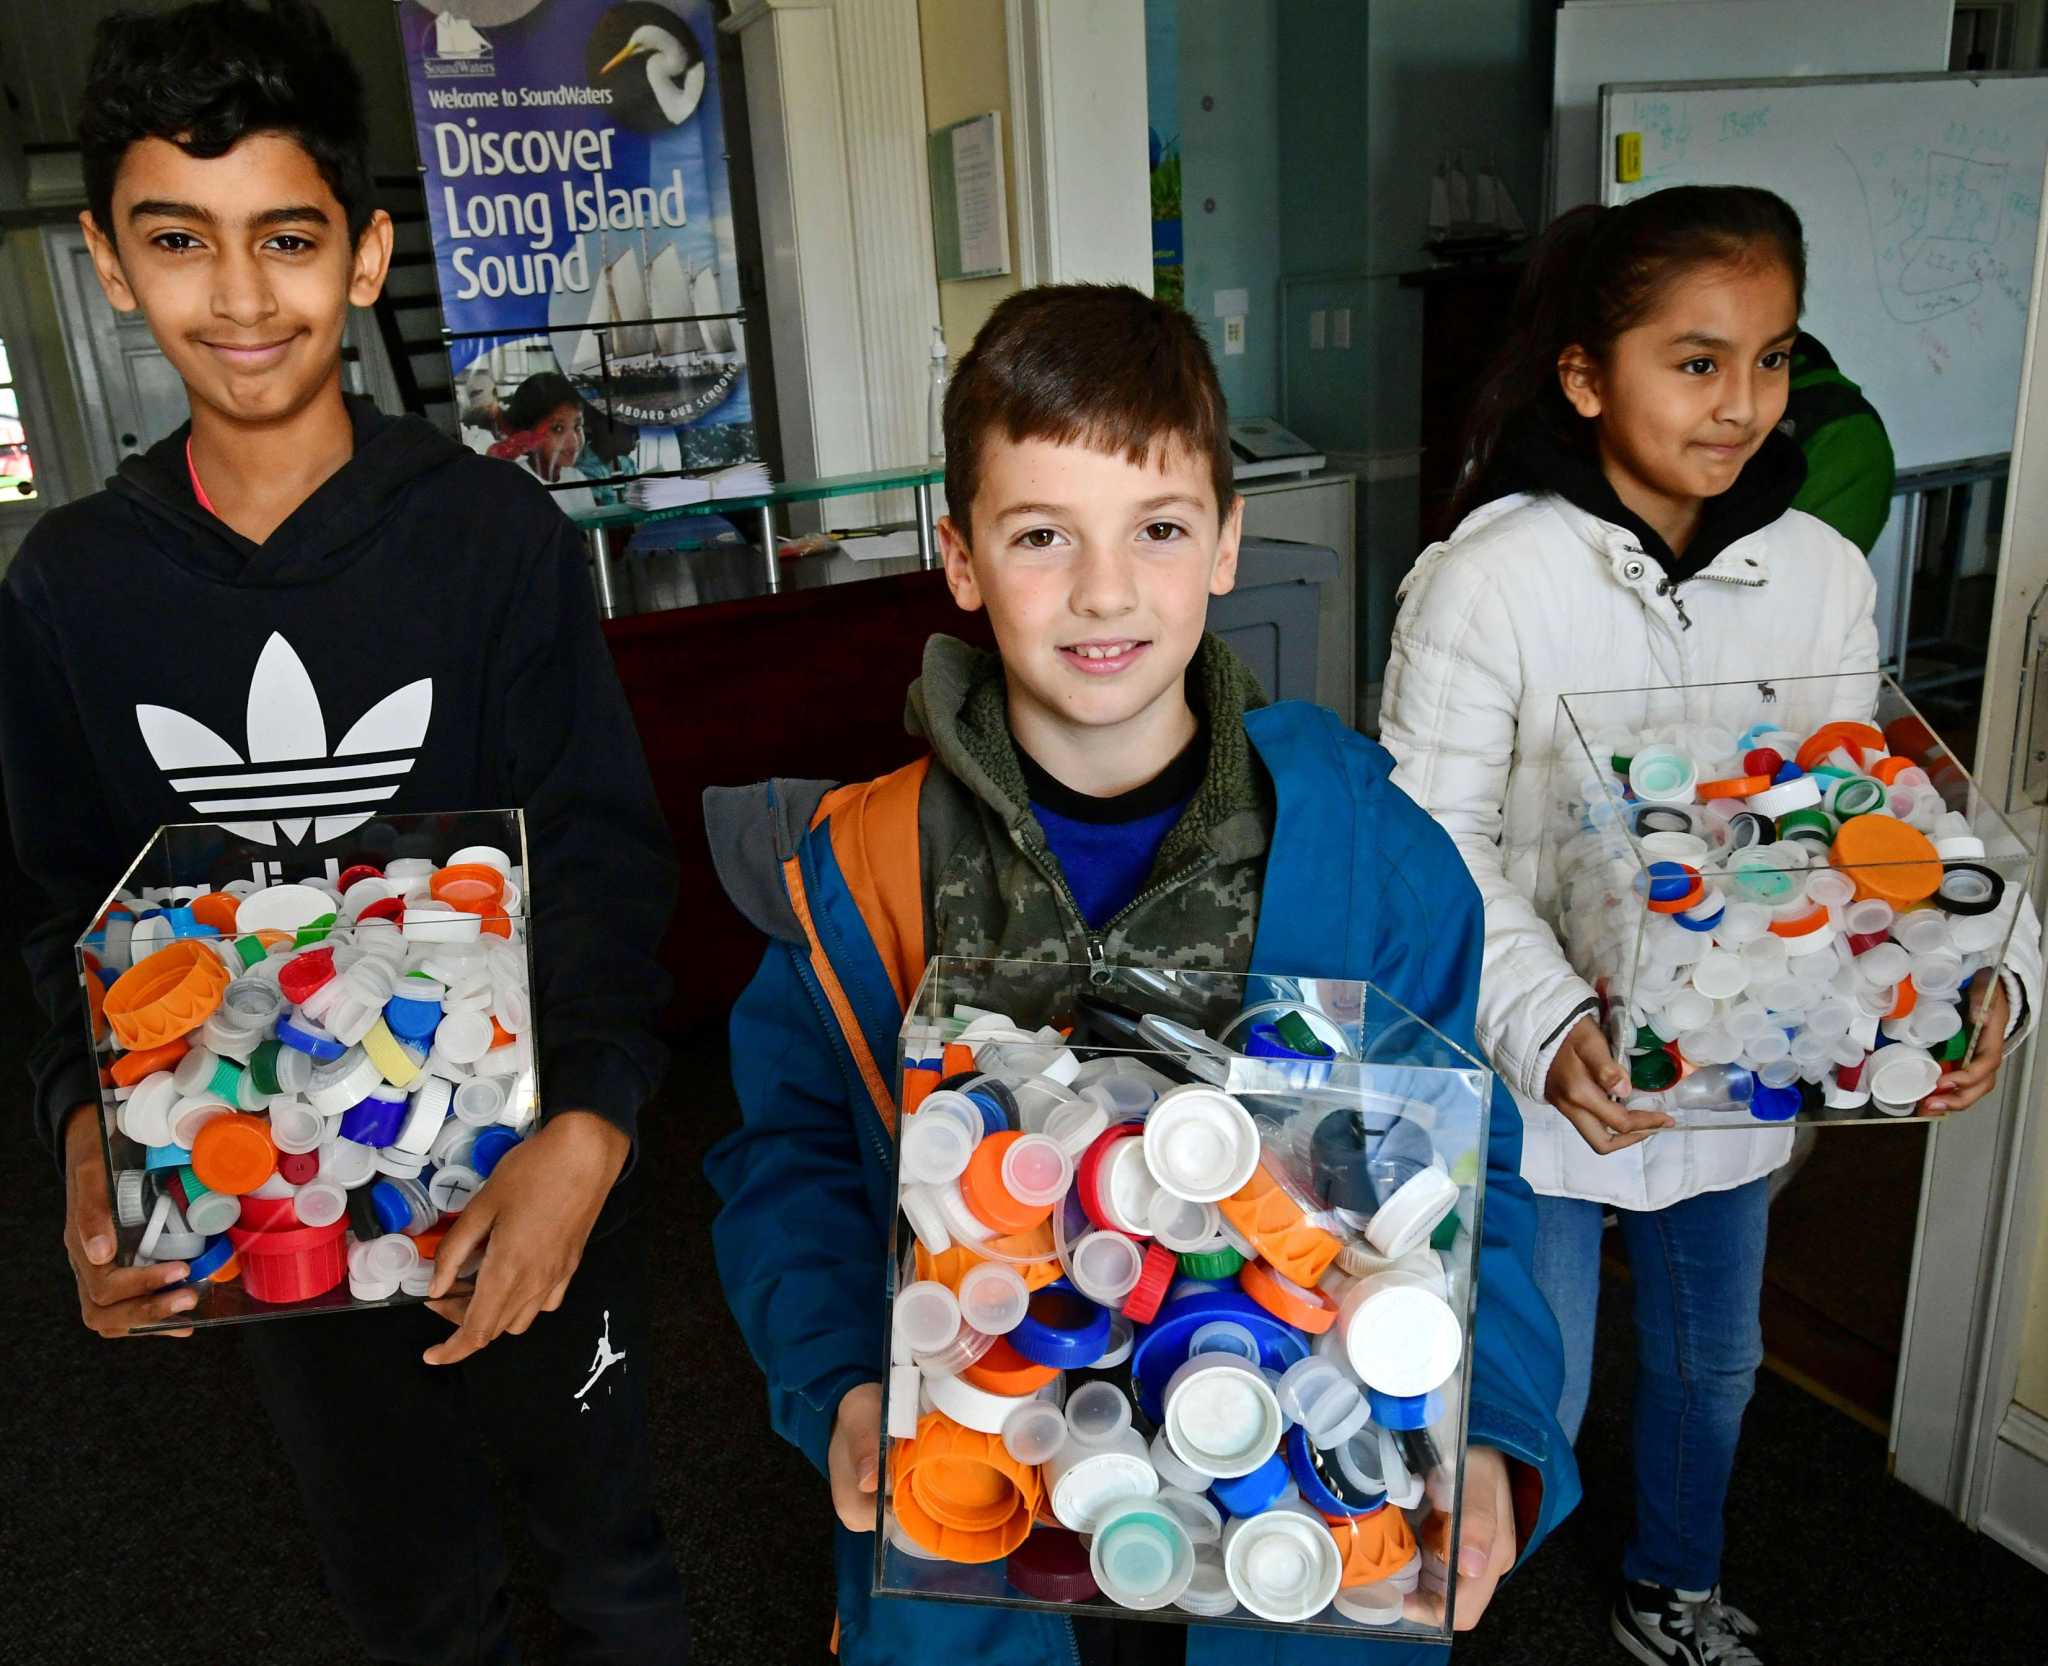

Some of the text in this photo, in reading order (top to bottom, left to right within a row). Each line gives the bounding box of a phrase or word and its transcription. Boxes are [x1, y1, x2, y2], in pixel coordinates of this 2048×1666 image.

[424, 59, 495, 75] SoundWaters
[428, 84, 614, 109] Welcome to SoundWaters
[434, 117, 615, 178] Discover
[443, 168, 687, 250] Long Island
[452, 233, 591, 300] Sound
[616, 402, 665, 421] ABOARD
[671, 403, 693, 419] OUR
